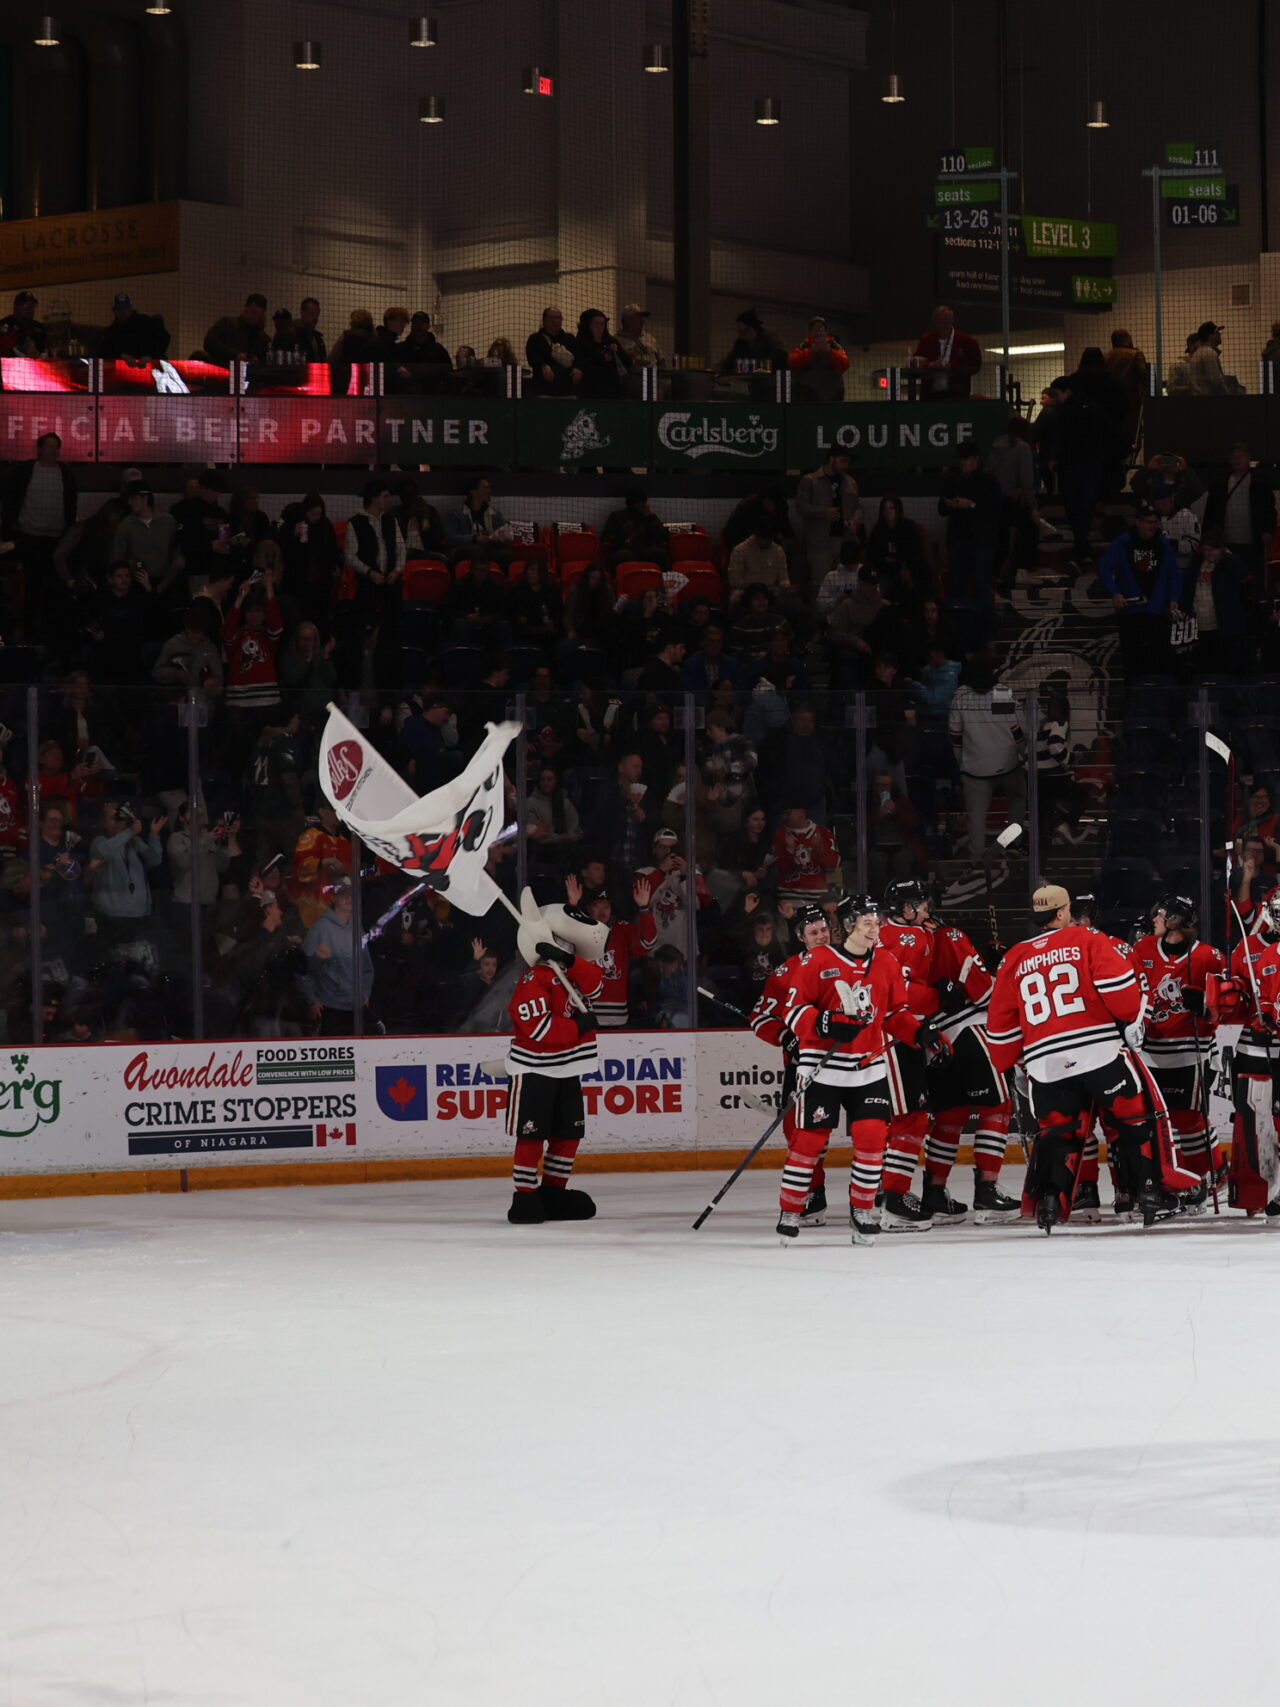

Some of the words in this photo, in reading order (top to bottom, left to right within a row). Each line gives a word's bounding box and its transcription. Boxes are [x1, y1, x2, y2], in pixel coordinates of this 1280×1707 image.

[940, 155, 965, 173] 110
[1194, 149, 1219, 167] 111
[937, 188, 971, 202] seats
[1188, 183, 1222, 197] seats
[944, 209, 989, 229] 13-26
[1172, 204, 1218, 224] 01-06
[21, 218, 140, 253] LACROSSE
[1032, 221, 1078, 248] LEVEL
[1081, 226, 1092, 250] 3
[175, 417, 279, 443] BEER
[301, 418, 489, 445] PARTNER
[657, 412, 778, 459] Carlsberg
[1019, 963, 1087, 1026] 82
[517, 997, 548, 1022] 911
[753, 995, 779, 1017] 27
[256, 1049, 298, 1063] FOOD
[300, 1046, 356, 1061] STORES
[123, 1050, 254, 1092] Avondale
[257, 1070, 301, 1079] CONVENIENCE
[301, 1069, 318, 1078] WITH
[318, 1069, 332, 1077] LOW
[333, 1067, 355, 1077] PRICES
[124, 1101, 217, 1127] CRIME
[222, 1093, 357, 1122] STOPPERS
[174, 1139, 191, 1149] OF
[200, 1136, 269, 1148] NIAGARA
